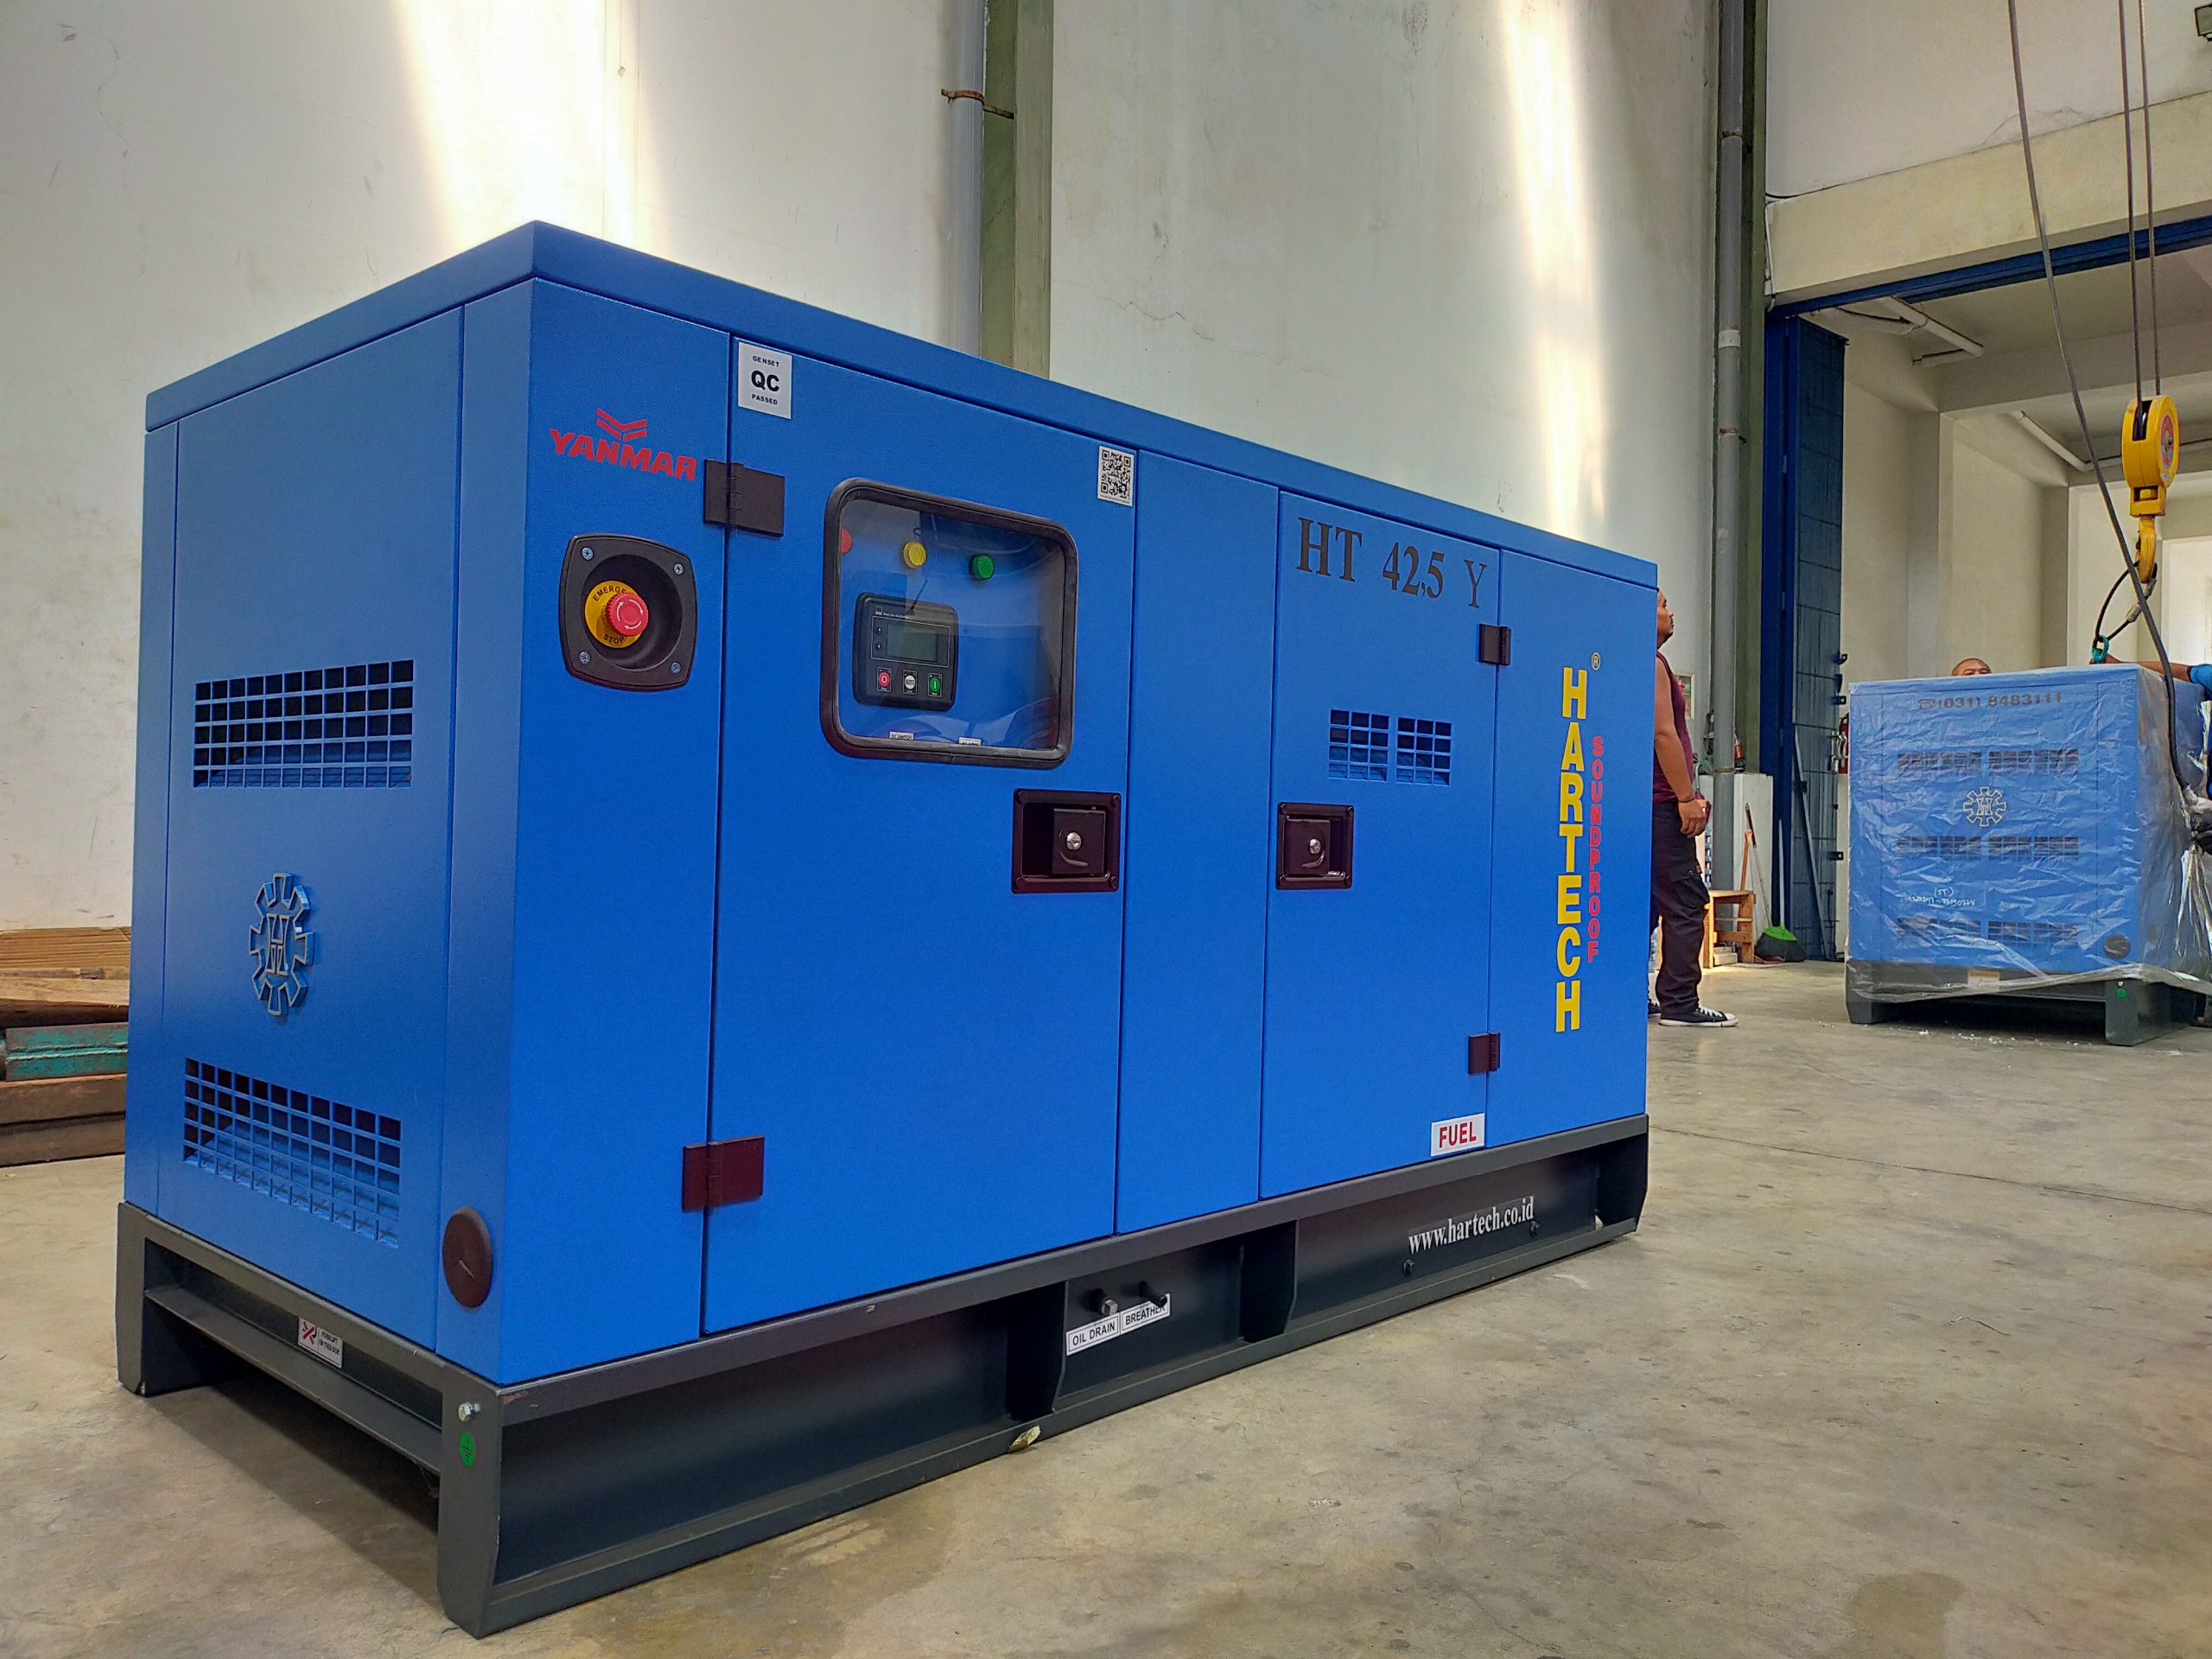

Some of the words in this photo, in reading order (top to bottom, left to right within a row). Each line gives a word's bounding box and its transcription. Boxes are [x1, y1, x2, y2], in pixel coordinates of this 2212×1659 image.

[753, 355, 779, 367] GENSET
[751, 370, 780, 392] QC
[752, 393, 778, 405] PASSED
[550, 428, 696, 480] YANMAR
[1296, 517, 1363, 582] HT
[1382, 542, 1445, 599] 42,5
[1464, 559, 1487, 608] Y
[593, 585, 626, 601] EMERGE
[602, 633, 625, 645] STOP
[1555, 667, 1587, 1033] HARTECH
[1587, 735, 1605, 963] SOUNDPROOF
[1439, 1122, 1477, 1148] FUEL
[1408, 1196, 1535, 1255] www.hartech.co.id
[1072, 1333, 1087, 1346] OIL
[1089, 1321, 1116, 1340] DRAIN
